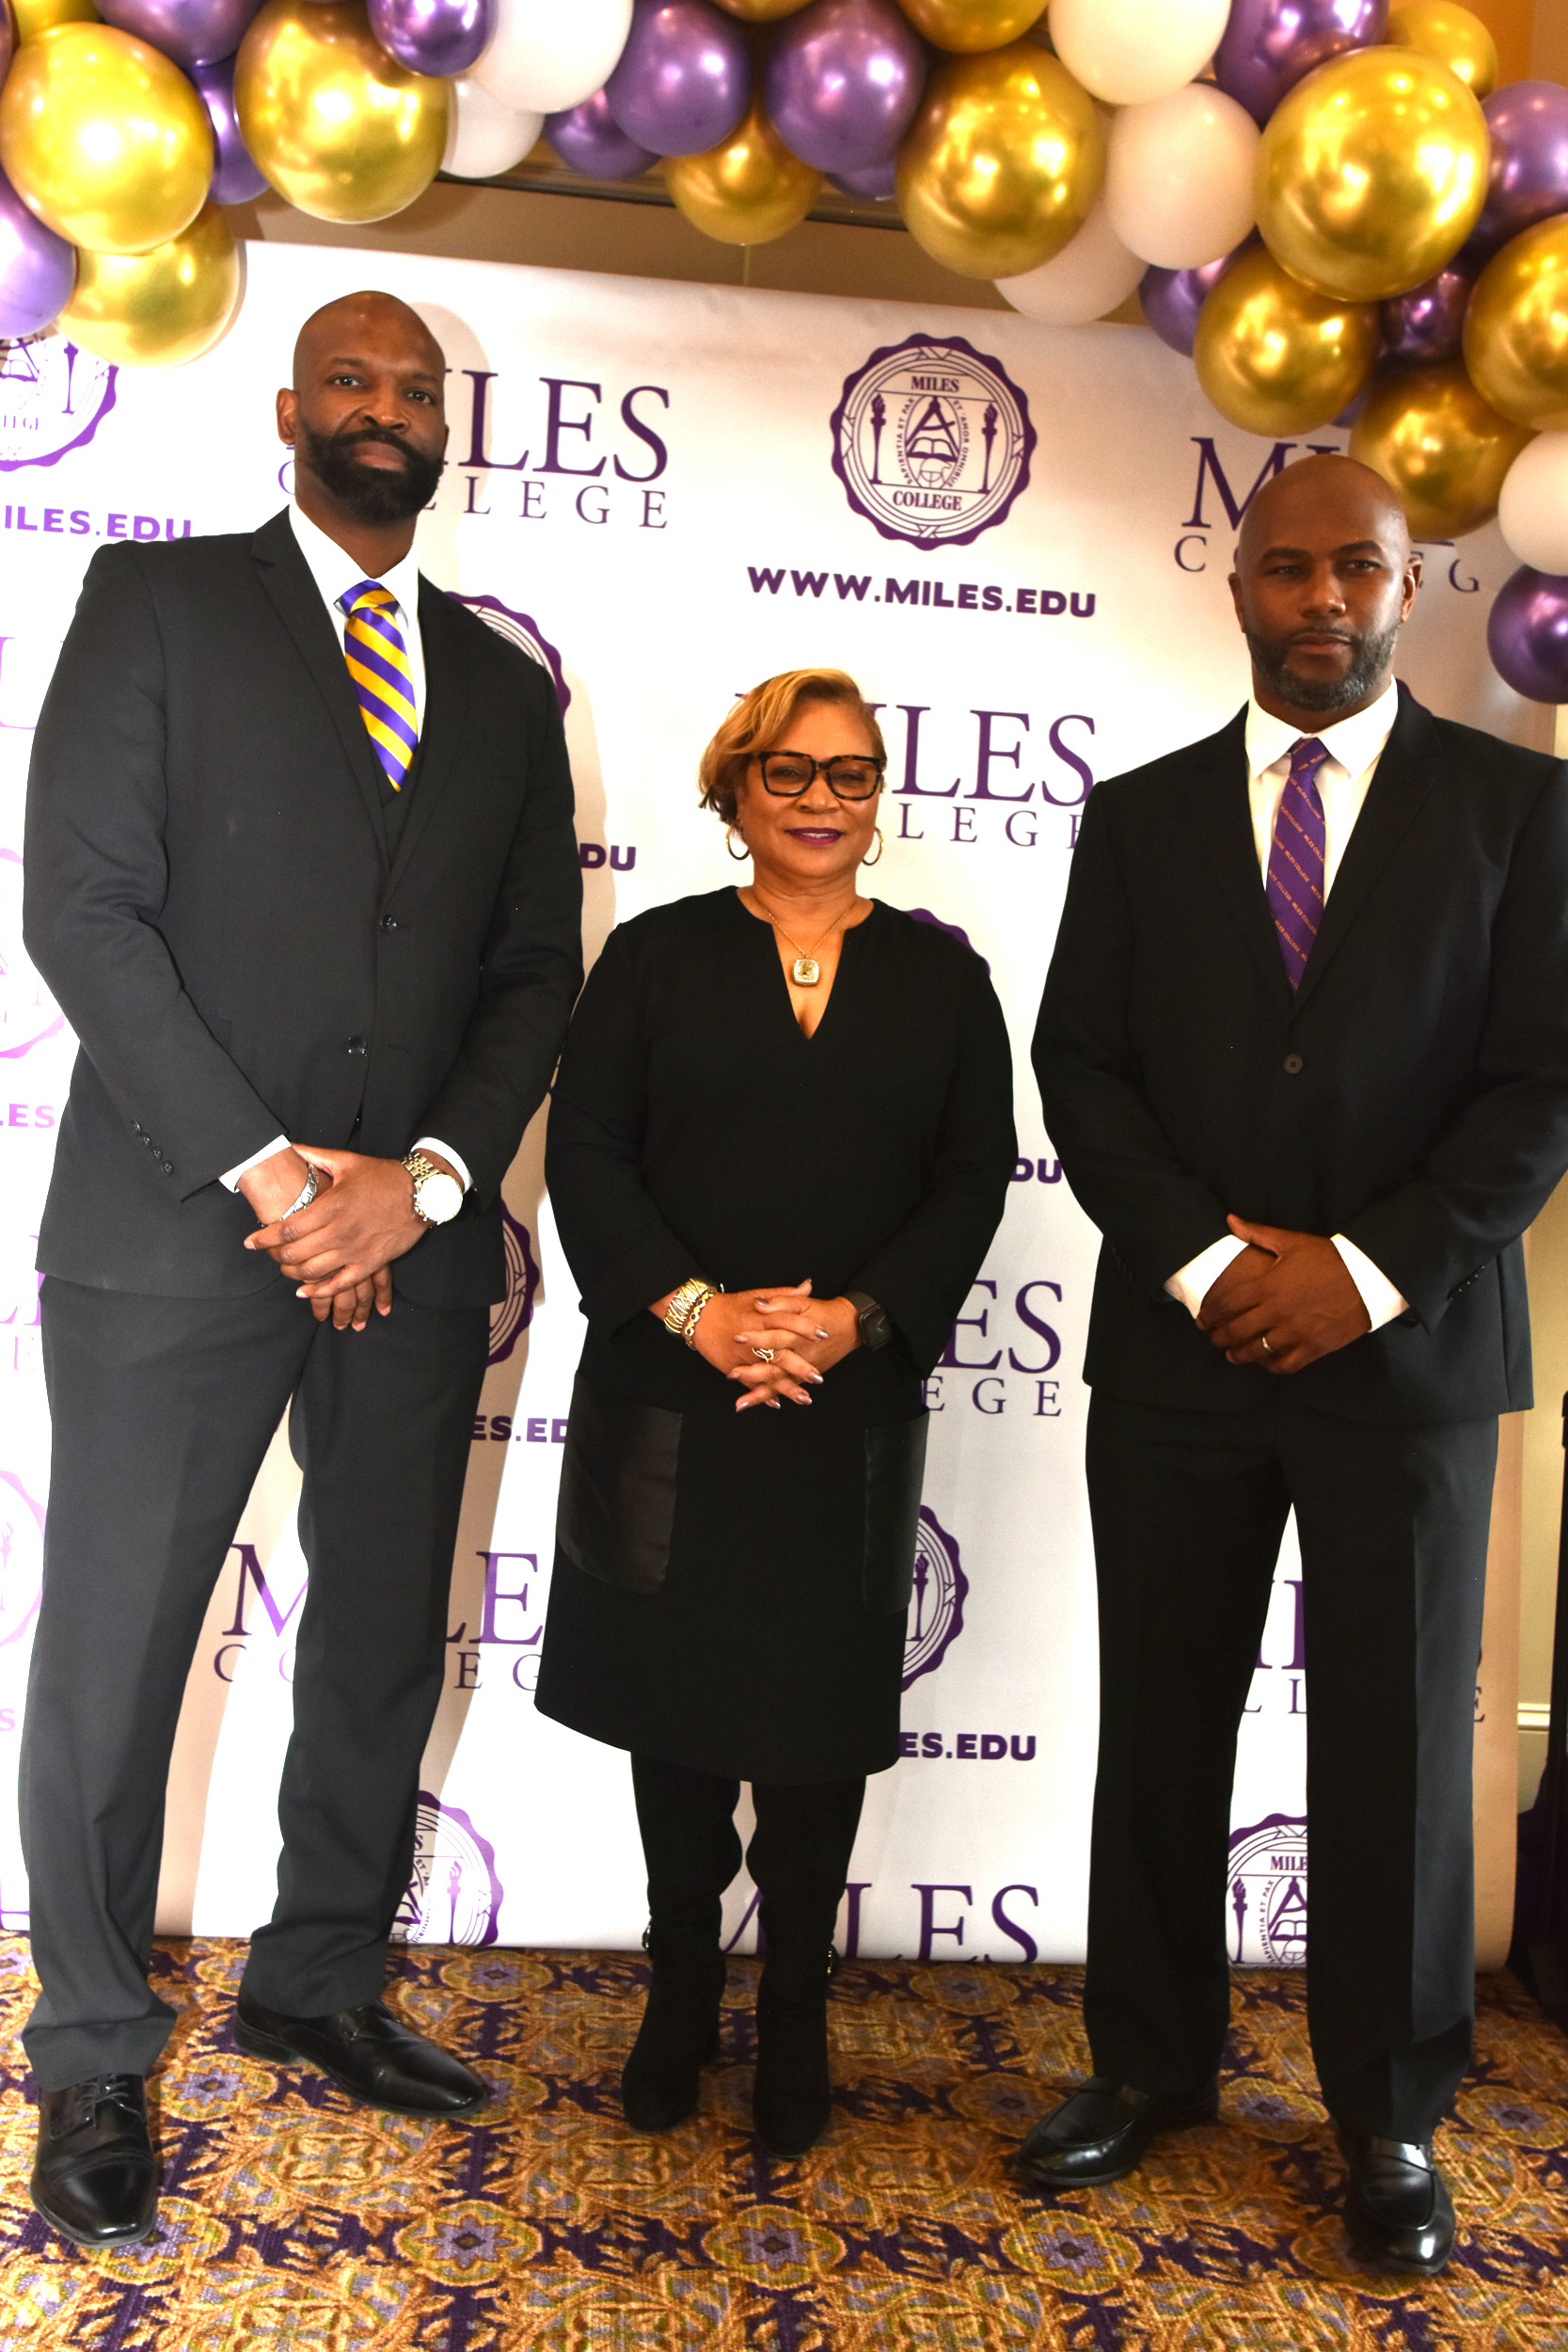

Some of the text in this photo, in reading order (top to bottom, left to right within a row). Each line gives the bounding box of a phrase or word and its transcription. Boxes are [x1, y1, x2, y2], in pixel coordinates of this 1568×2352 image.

[911, 375, 959, 393] MILES
[893, 490, 962, 512] COLLEGE
[747, 566, 1097, 618] WWW.MILES.EDU
